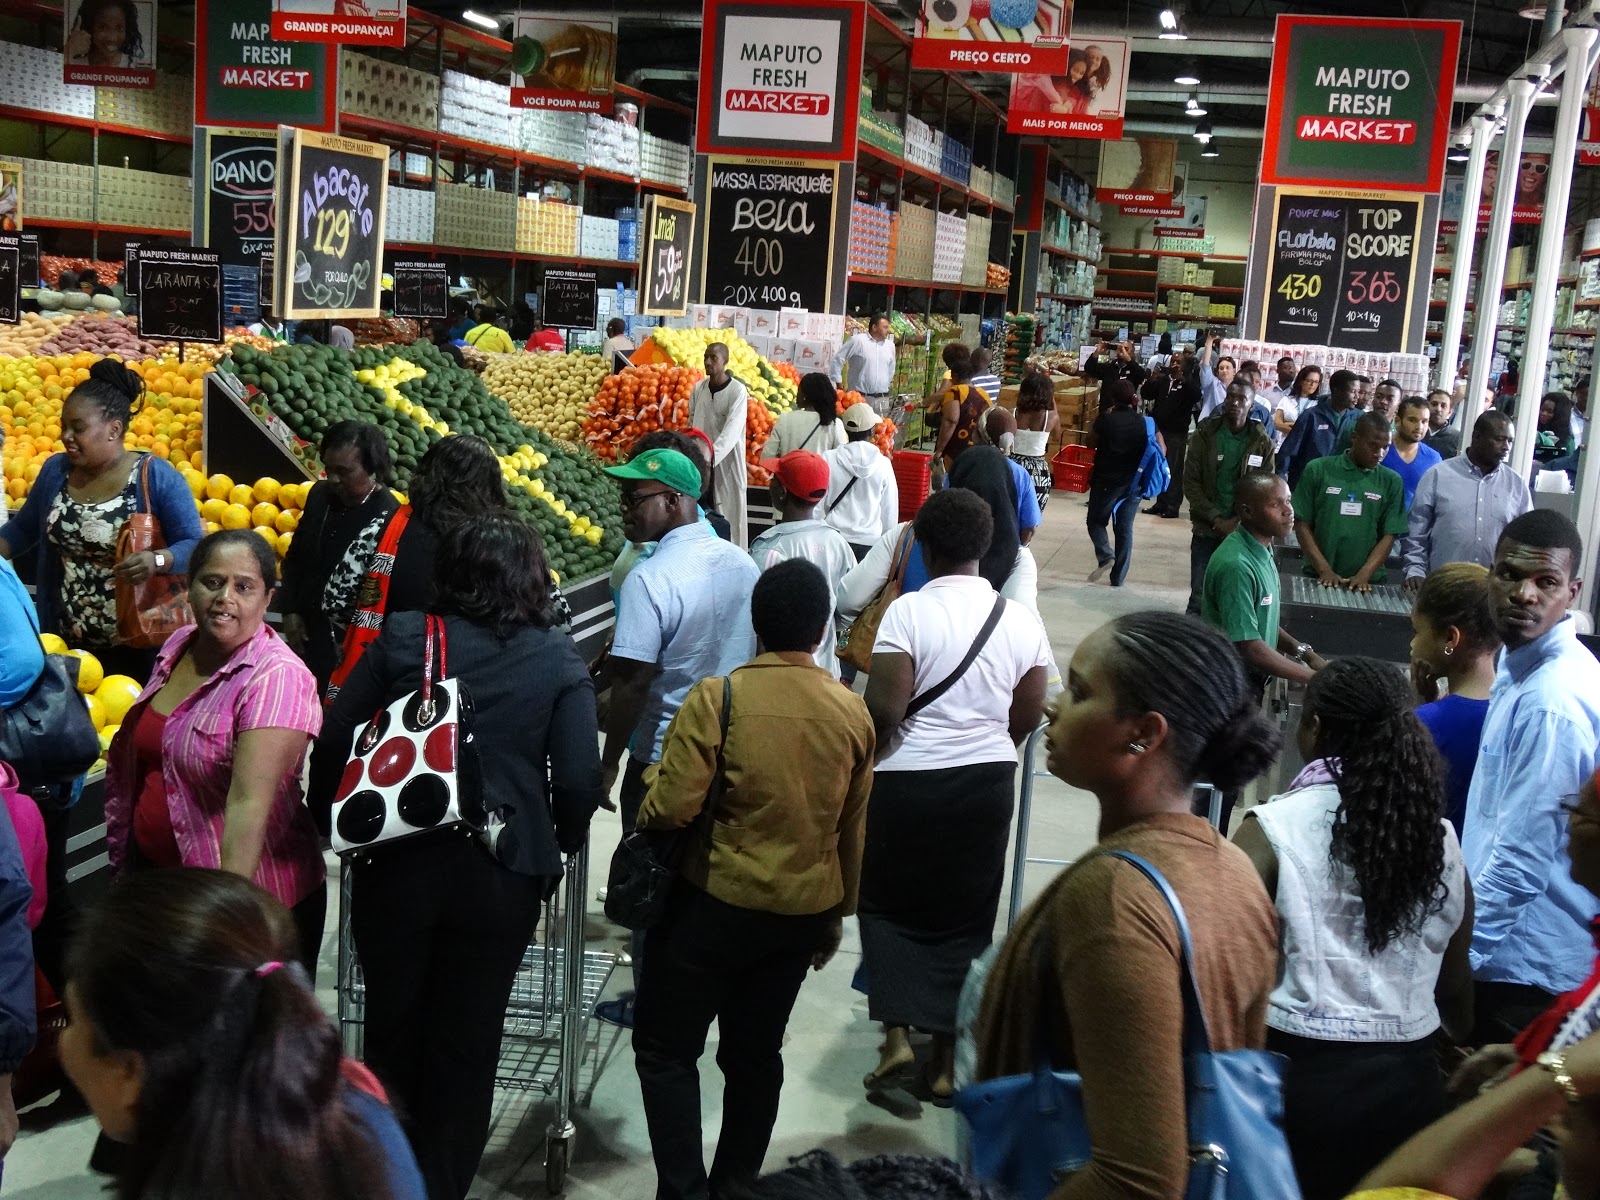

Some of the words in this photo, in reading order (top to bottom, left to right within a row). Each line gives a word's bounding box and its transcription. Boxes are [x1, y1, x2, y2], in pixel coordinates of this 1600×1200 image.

[283, 20, 328, 34] GRANDE
[331, 23, 394, 38] POUPANÇA!
[243, 45, 292, 65] FRESH
[740, 42, 822, 64] MAPUTO
[950, 49, 989, 64] PREÇO
[992, 52, 1031, 64] CERTO
[70, 72, 102, 82] GRANDE
[104, 74, 150, 85] POUPANÇA!
[222, 69, 310, 88] MARKET
[753, 68, 807, 89] FRESH
[1315, 66, 1410, 91] MAPUTO
[522, 96, 545, 106] VOCÊ
[547, 98, 576, 108] POUPA
[579, 100, 600, 109] MAIS
[728, 92, 826, 114] MARKET
[1328, 94, 1391, 116] FRESH
[1022, 118, 1046, 128] MAIS
[1048, 120, 1067, 130] POR
[1069, 121, 1104, 132] MENOS
[1300, 120, 1412, 141] MARKET
[215, 159, 275, 184] DANO
[713, 171, 757, 190] MASSA
[1113, 193, 1134, 201] PREÇO
[1135, 194, 1155, 202] CERTO
[1318, 189, 1343, 197] MAPUTO
[1288, 207, 1319, 219] POUPE
[1358, 208, 1402, 230] TOP
[1512, 212, 1543, 221] OUPANÇ
[0, 236, 19, 246] ARKET
[314, 207, 350, 260] 129
[1346, 232, 1412, 260] SCORE
[139, 250, 169, 260] MAPUTO
[170, 251, 190, 261] FRESH
[191, 254, 219, 262] MARKET
[734, 236, 784, 277] 400
[1313, 251, 1332, 261] PARA
[761, 285, 787, 303] 400
[1277, 273, 1322, 301] 430
[1347, 271, 1401, 305] 365
